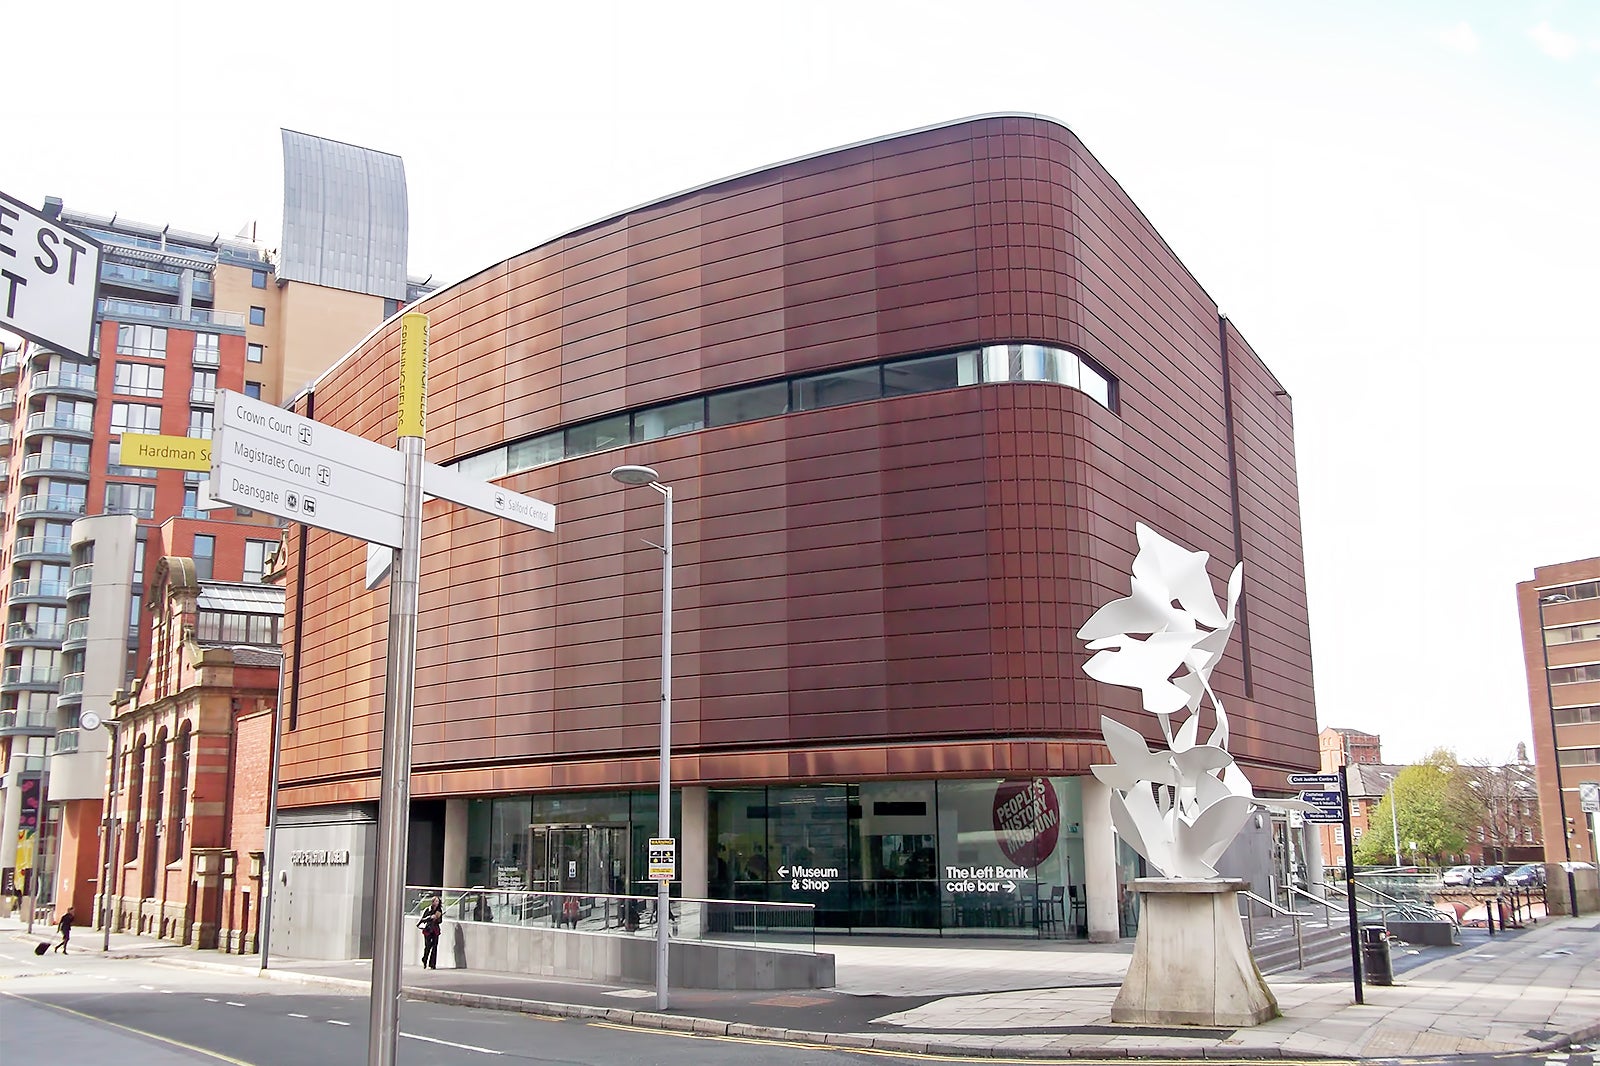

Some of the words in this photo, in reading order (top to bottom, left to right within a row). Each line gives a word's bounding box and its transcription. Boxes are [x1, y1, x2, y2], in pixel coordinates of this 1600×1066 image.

[34, 227, 87, 286] ST
[236, 405, 266, 427] Crown
[268, 416, 293, 437] Court
[139, 444, 196, 460] Hardman
[234, 441, 286, 470] Magistrates
[287, 458, 312, 478] Court
[232, 478, 280, 504] Deansgate
[508, 499, 528, 516] Salford
[528, 506, 549, 521] Central
[996, 778, 1046, 823] PEOPLE'S
[1001, 794, 1048, 838] HISTORY
[1006, 809, 1057, 855] MUSEUM
[791, 865, 839, 878] Museum
[945, 866, 969, 879] The
[970, 866, 994, 879] Left
[995, 866, 1029, 879] Bank
[791, 878, 800, 891] &
[801, 878, 830, 893] Shop
[946, 880, 975, 892] cafe
[977, 880, 1000, 892] bar
